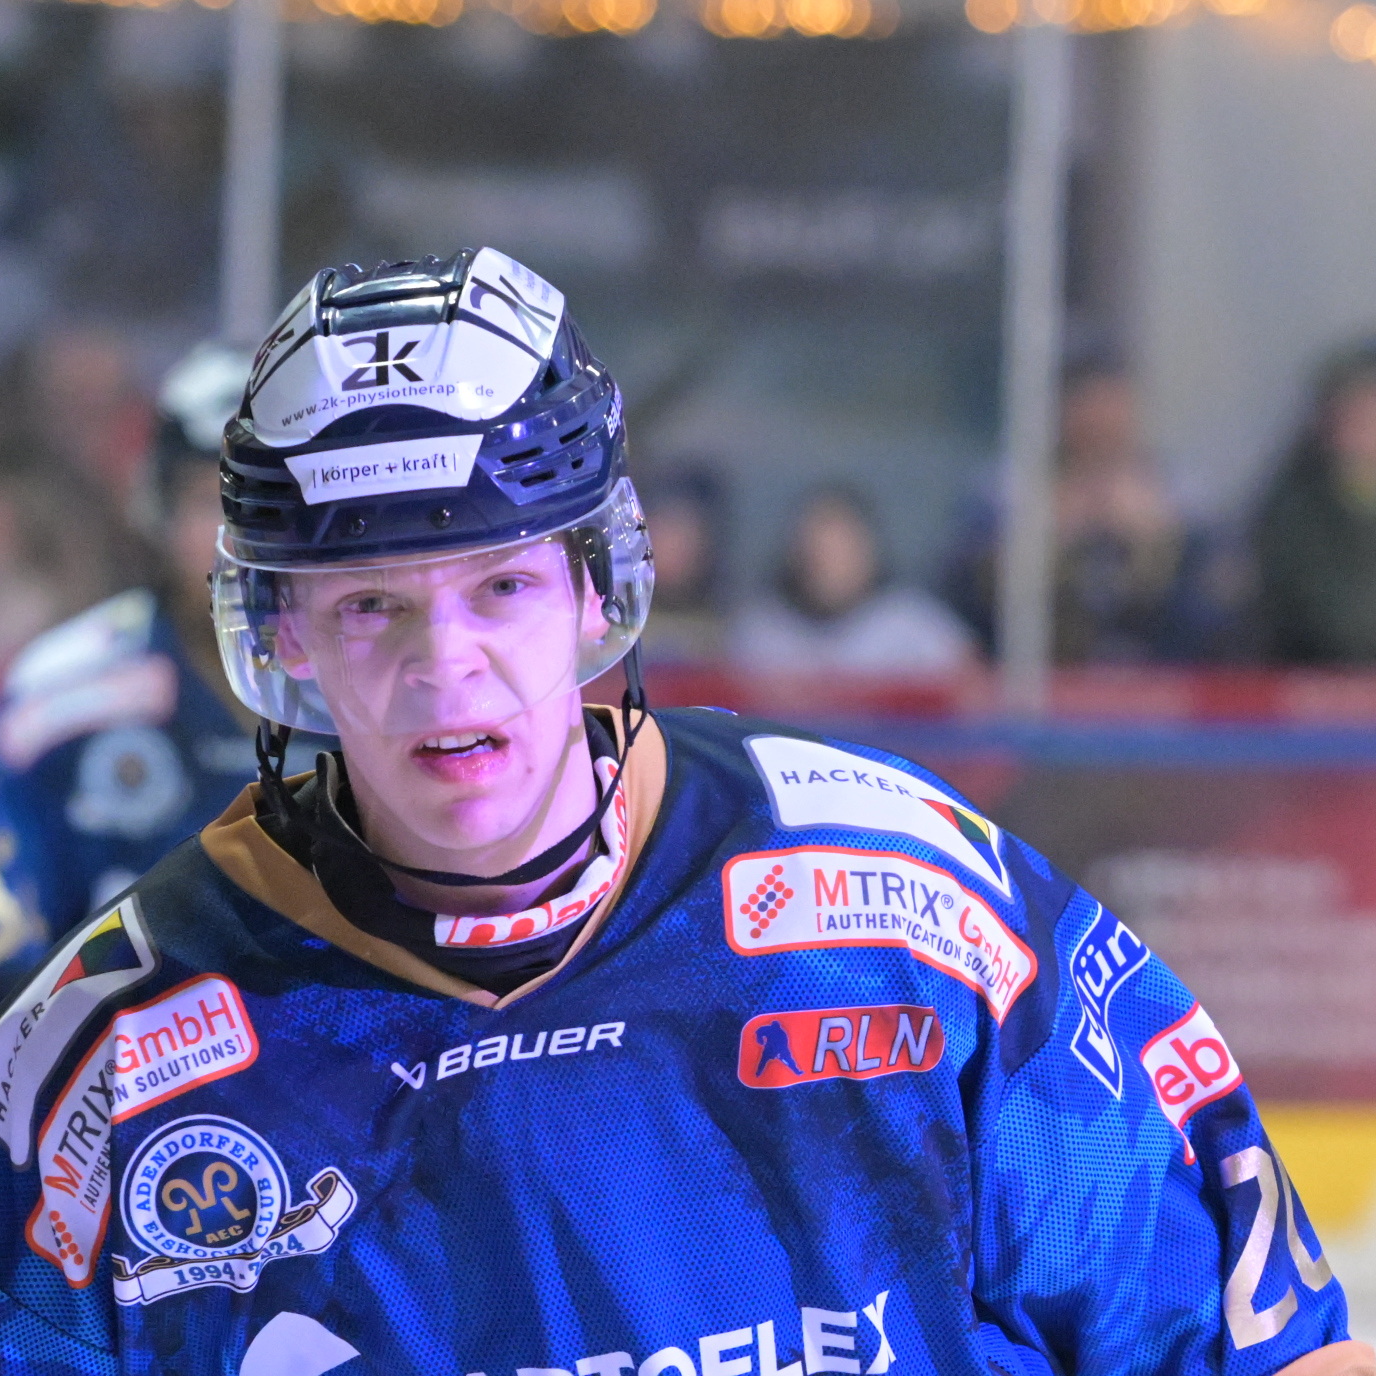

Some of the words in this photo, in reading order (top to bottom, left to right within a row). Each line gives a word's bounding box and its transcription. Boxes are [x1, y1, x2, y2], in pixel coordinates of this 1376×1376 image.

[280, 381, 495, 428] www.2k-physiotherapde
[320, 457, 381, 491] körper
[401, 452, 449, 475] kraft
[779, 768, 916, 799] HACKER
[114, 991, 237, 1075] GmbH
[811, 1012, 935, 1074] RLN
[136, 1131, 260, 1212] ADENDORFER
[205, 1224, 245, 1244] AEC
[255, 1177, 274, 1238] CLUB
